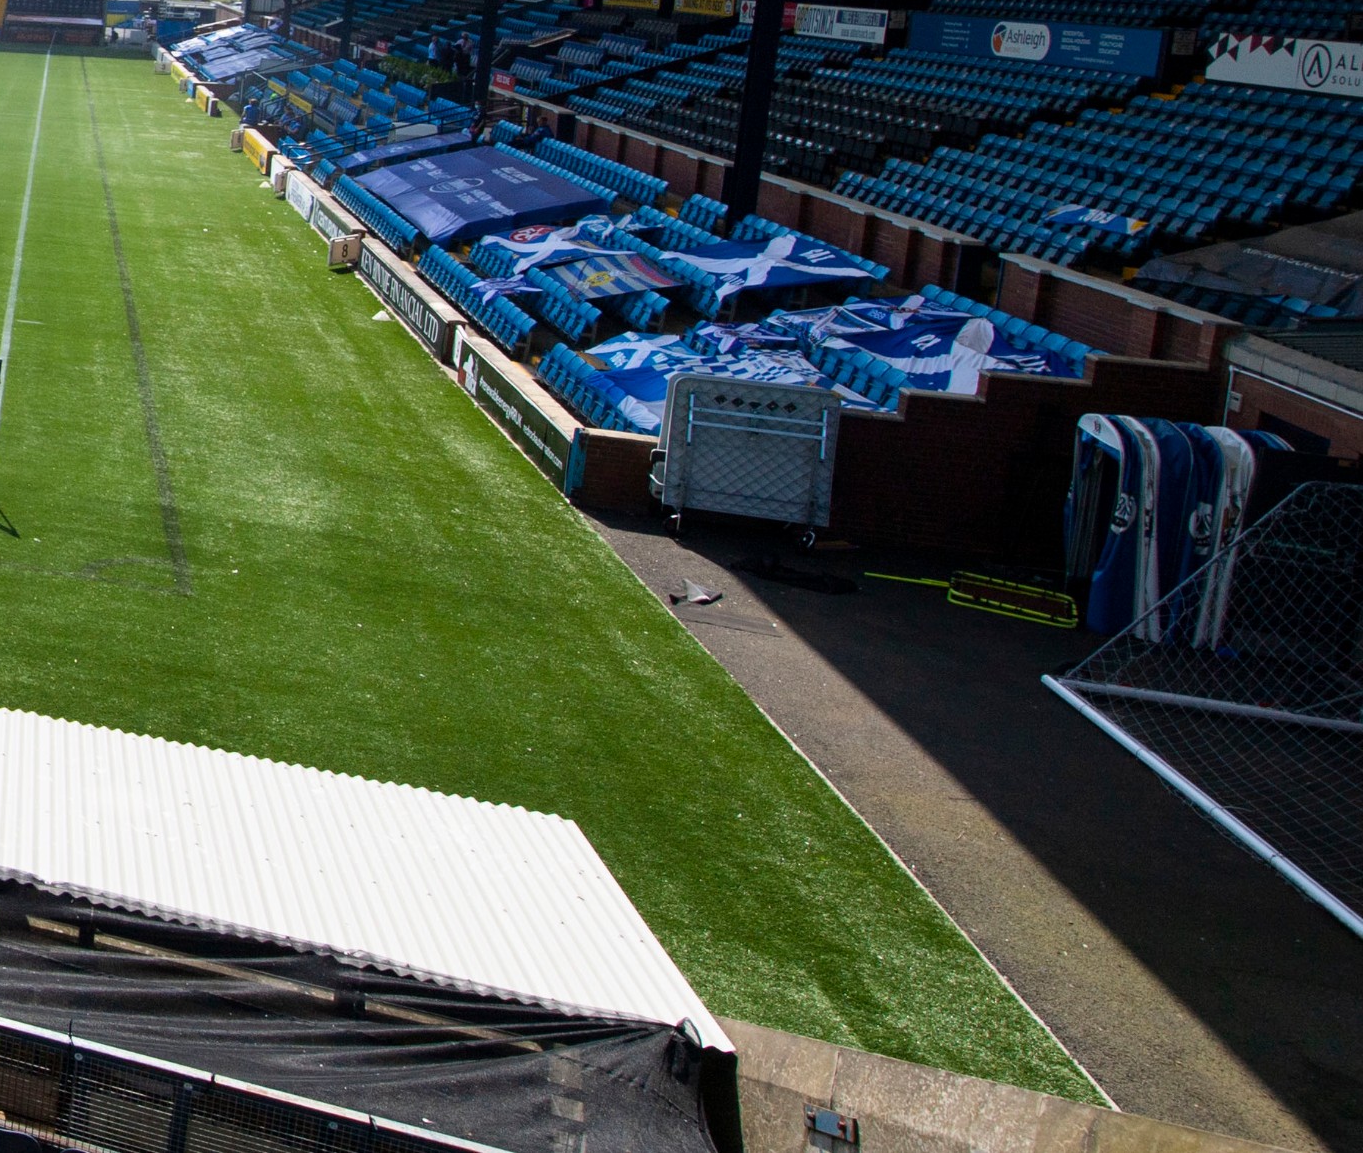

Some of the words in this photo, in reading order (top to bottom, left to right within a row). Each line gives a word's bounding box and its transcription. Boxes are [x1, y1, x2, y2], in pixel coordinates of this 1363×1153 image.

[1005, 29, 1046, 47] Ashleigh
[1335, 55, 1363, 72] AL
[341, 244, 348, 258] 8
[361, 248, 374, 274] KEN
[390, 277, 424, 329] FINANCIAL
[423, 310, 439, 343] LTD
